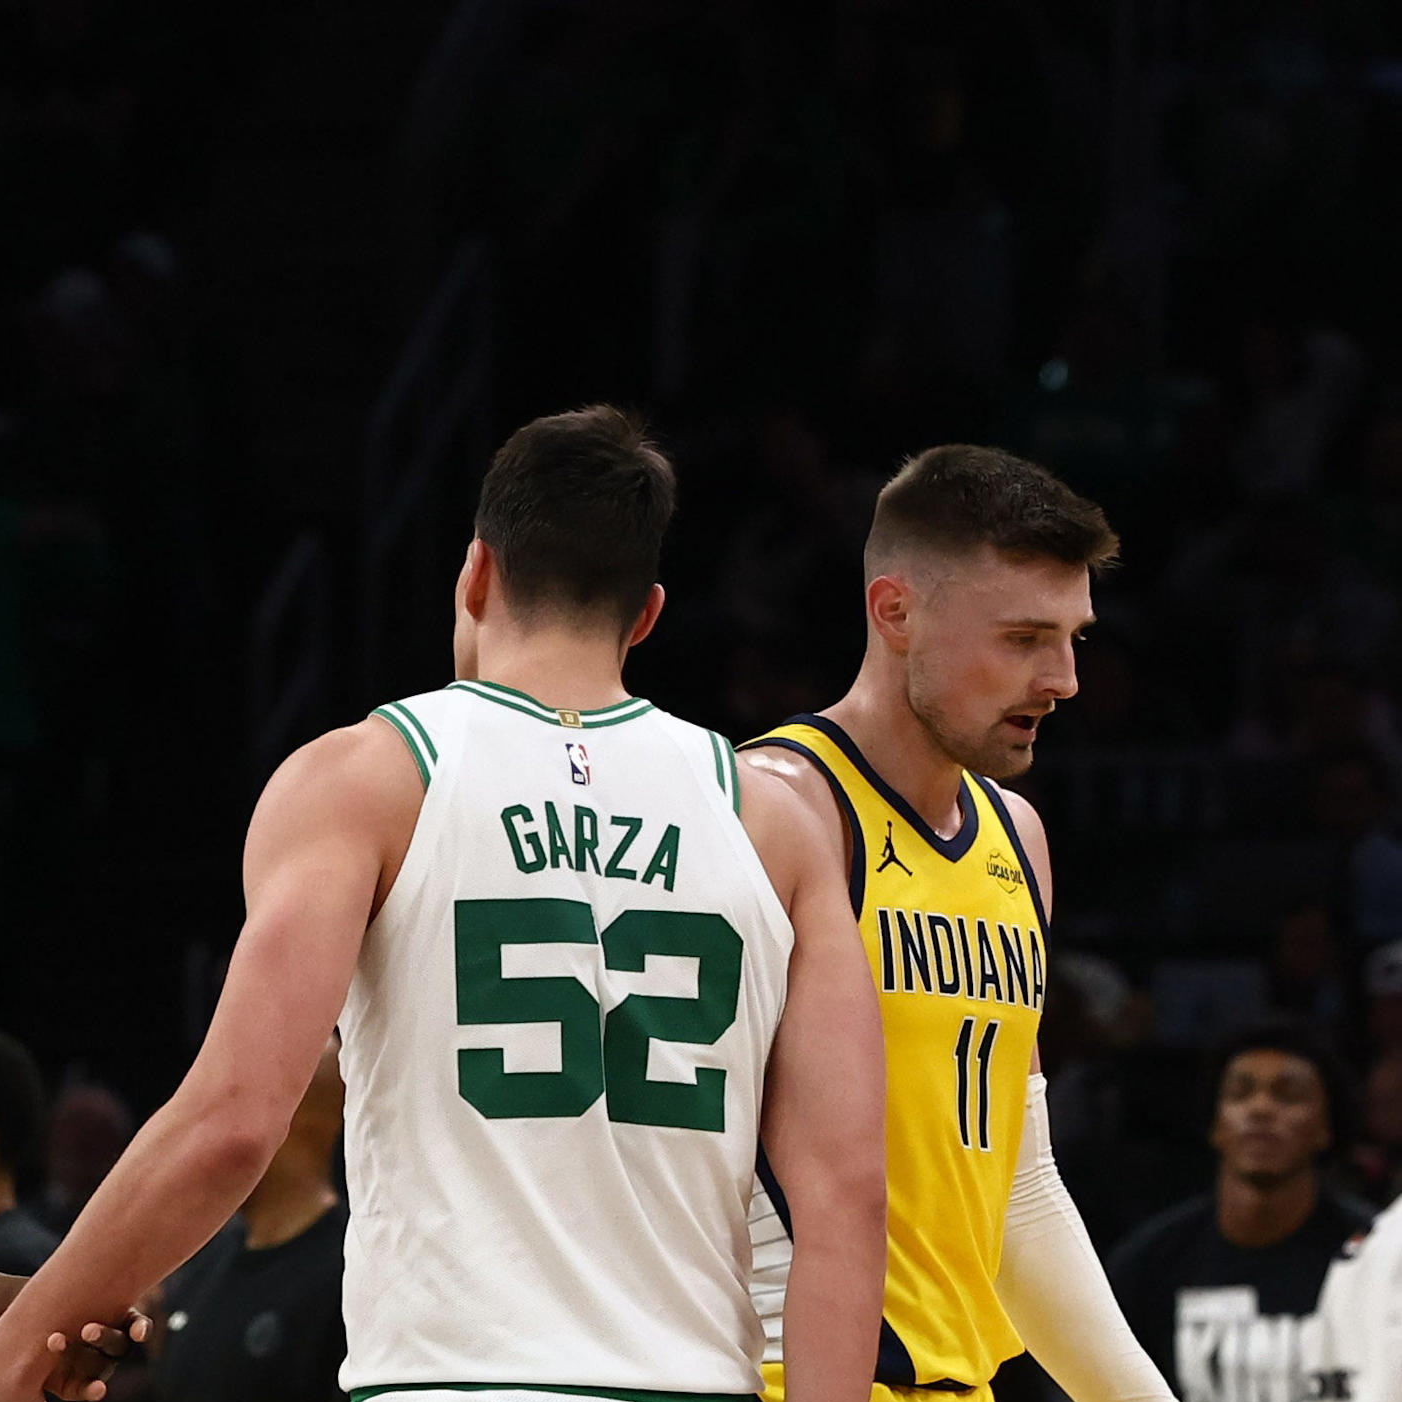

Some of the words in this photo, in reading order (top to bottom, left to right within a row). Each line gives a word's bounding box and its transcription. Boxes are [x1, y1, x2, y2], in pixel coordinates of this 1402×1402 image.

[501, 801, 680, 892] GARZA
[987, 862, 1009, 881] LUCAS
[1010, 869, 1023, 884] OIL
[877, 907, 1043, 1012] INDIANA
[454, 898, 744, 1133] 52
[953, 1016, 1001, 1151] 11
